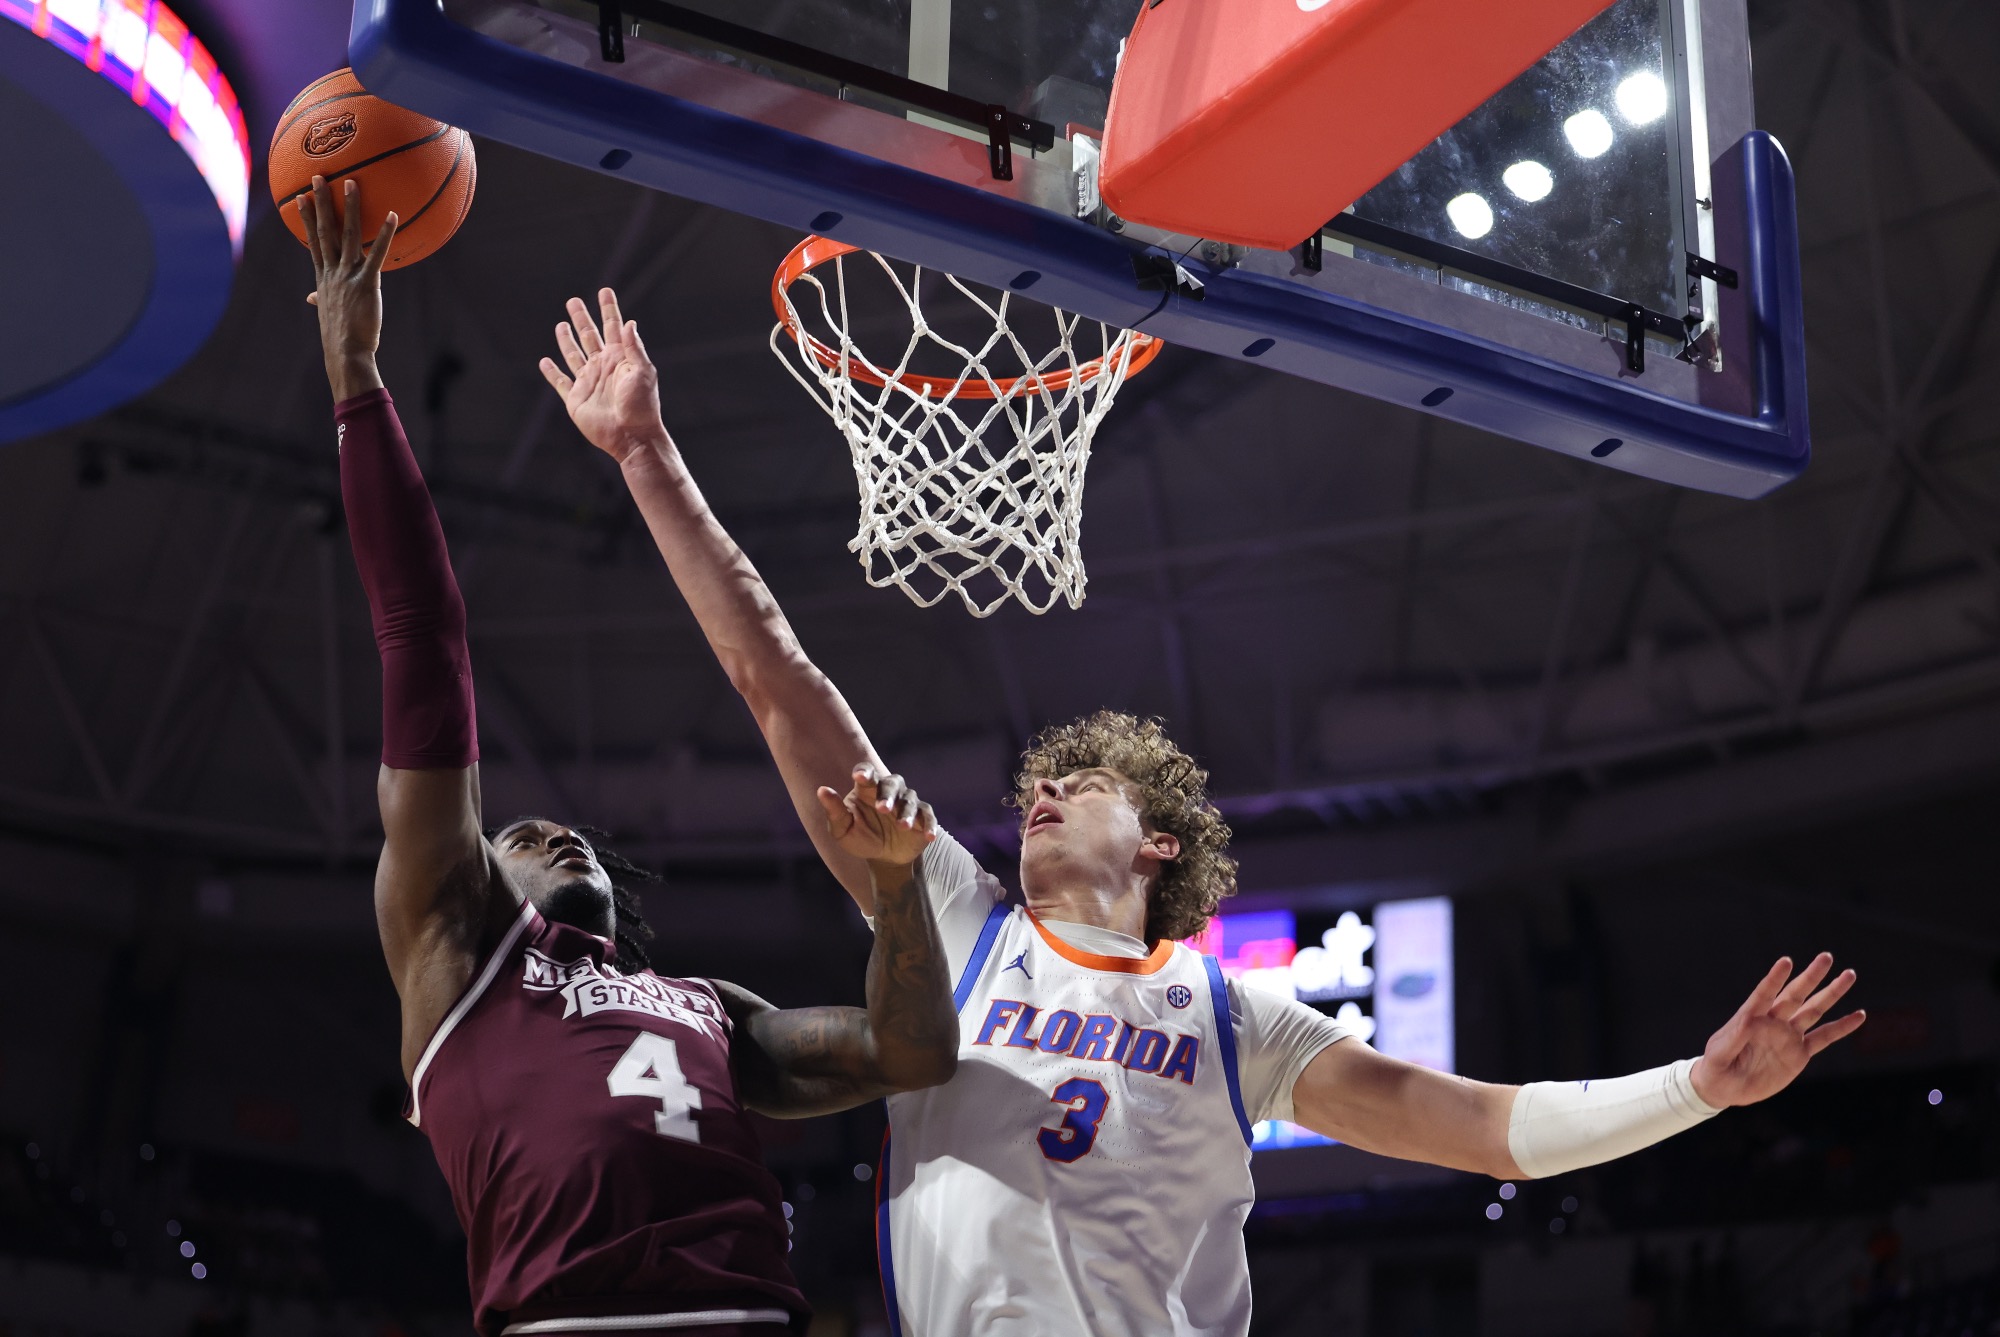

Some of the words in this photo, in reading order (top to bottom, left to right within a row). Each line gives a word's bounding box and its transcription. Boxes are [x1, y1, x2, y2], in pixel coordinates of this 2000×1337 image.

[523, 953, 723, 1022] MISSIPPI
[1169, 987, 1192, 1008] SEC
[971, 999, 1199, 1085] FLORIDA
[606, 1030, 702, 1144] 4
[1036, 1077, 1110, 1163] 3
